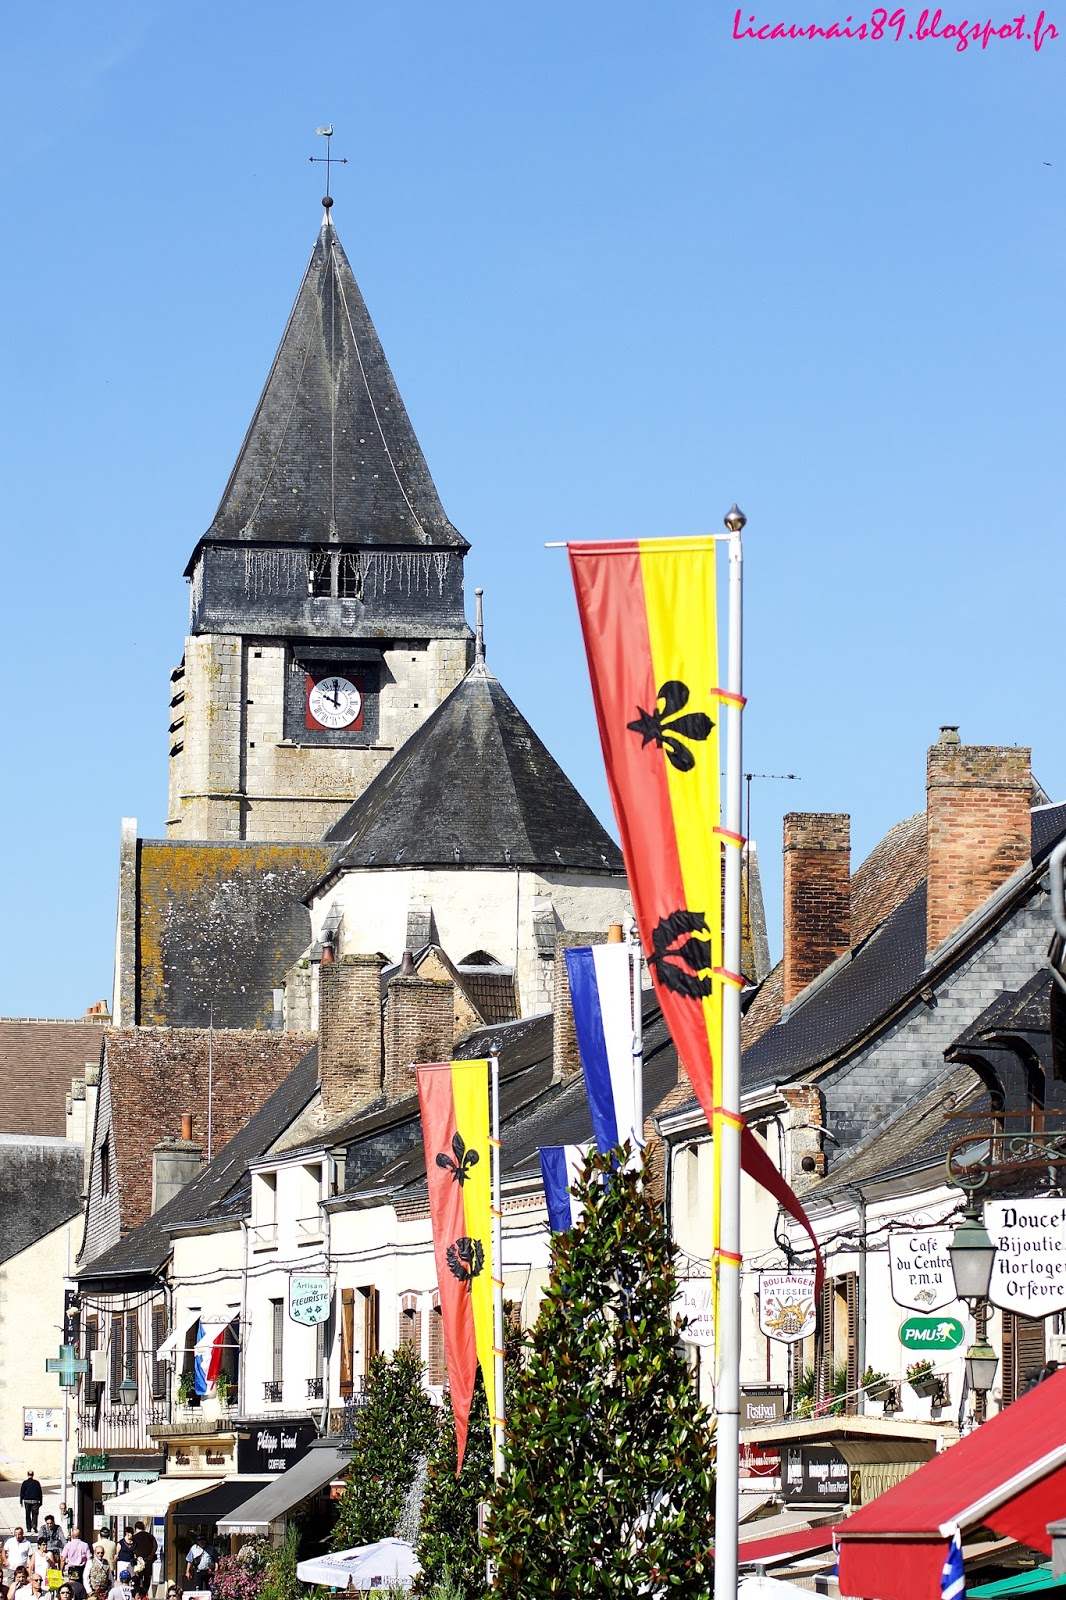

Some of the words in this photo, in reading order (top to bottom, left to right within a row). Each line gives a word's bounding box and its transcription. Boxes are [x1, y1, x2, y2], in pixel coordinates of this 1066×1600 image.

[909, 1238, 938, 1254] Café
[998, 1236, 1066, 1256] Bijoutie
[897, 1257, 911, 1271] du
[914, 1255, 952, 1269] Centre
[998, 1259, 1066, 1279] Horloge
[763, 1276, 815, 1288] BOULANGER
[764, 1288, 813, 1296] PATISSIER
[291, 1293, 329, 1307] FLEURISTE
[684, 1293, 696, 1306] La
[697, 1314, 715, 1322] aux
[905, 1329, 937, 1341] PMU
[746, 1402, 776, 1419] Festival
[268, 1459, 286, 1470] COIFFURE
